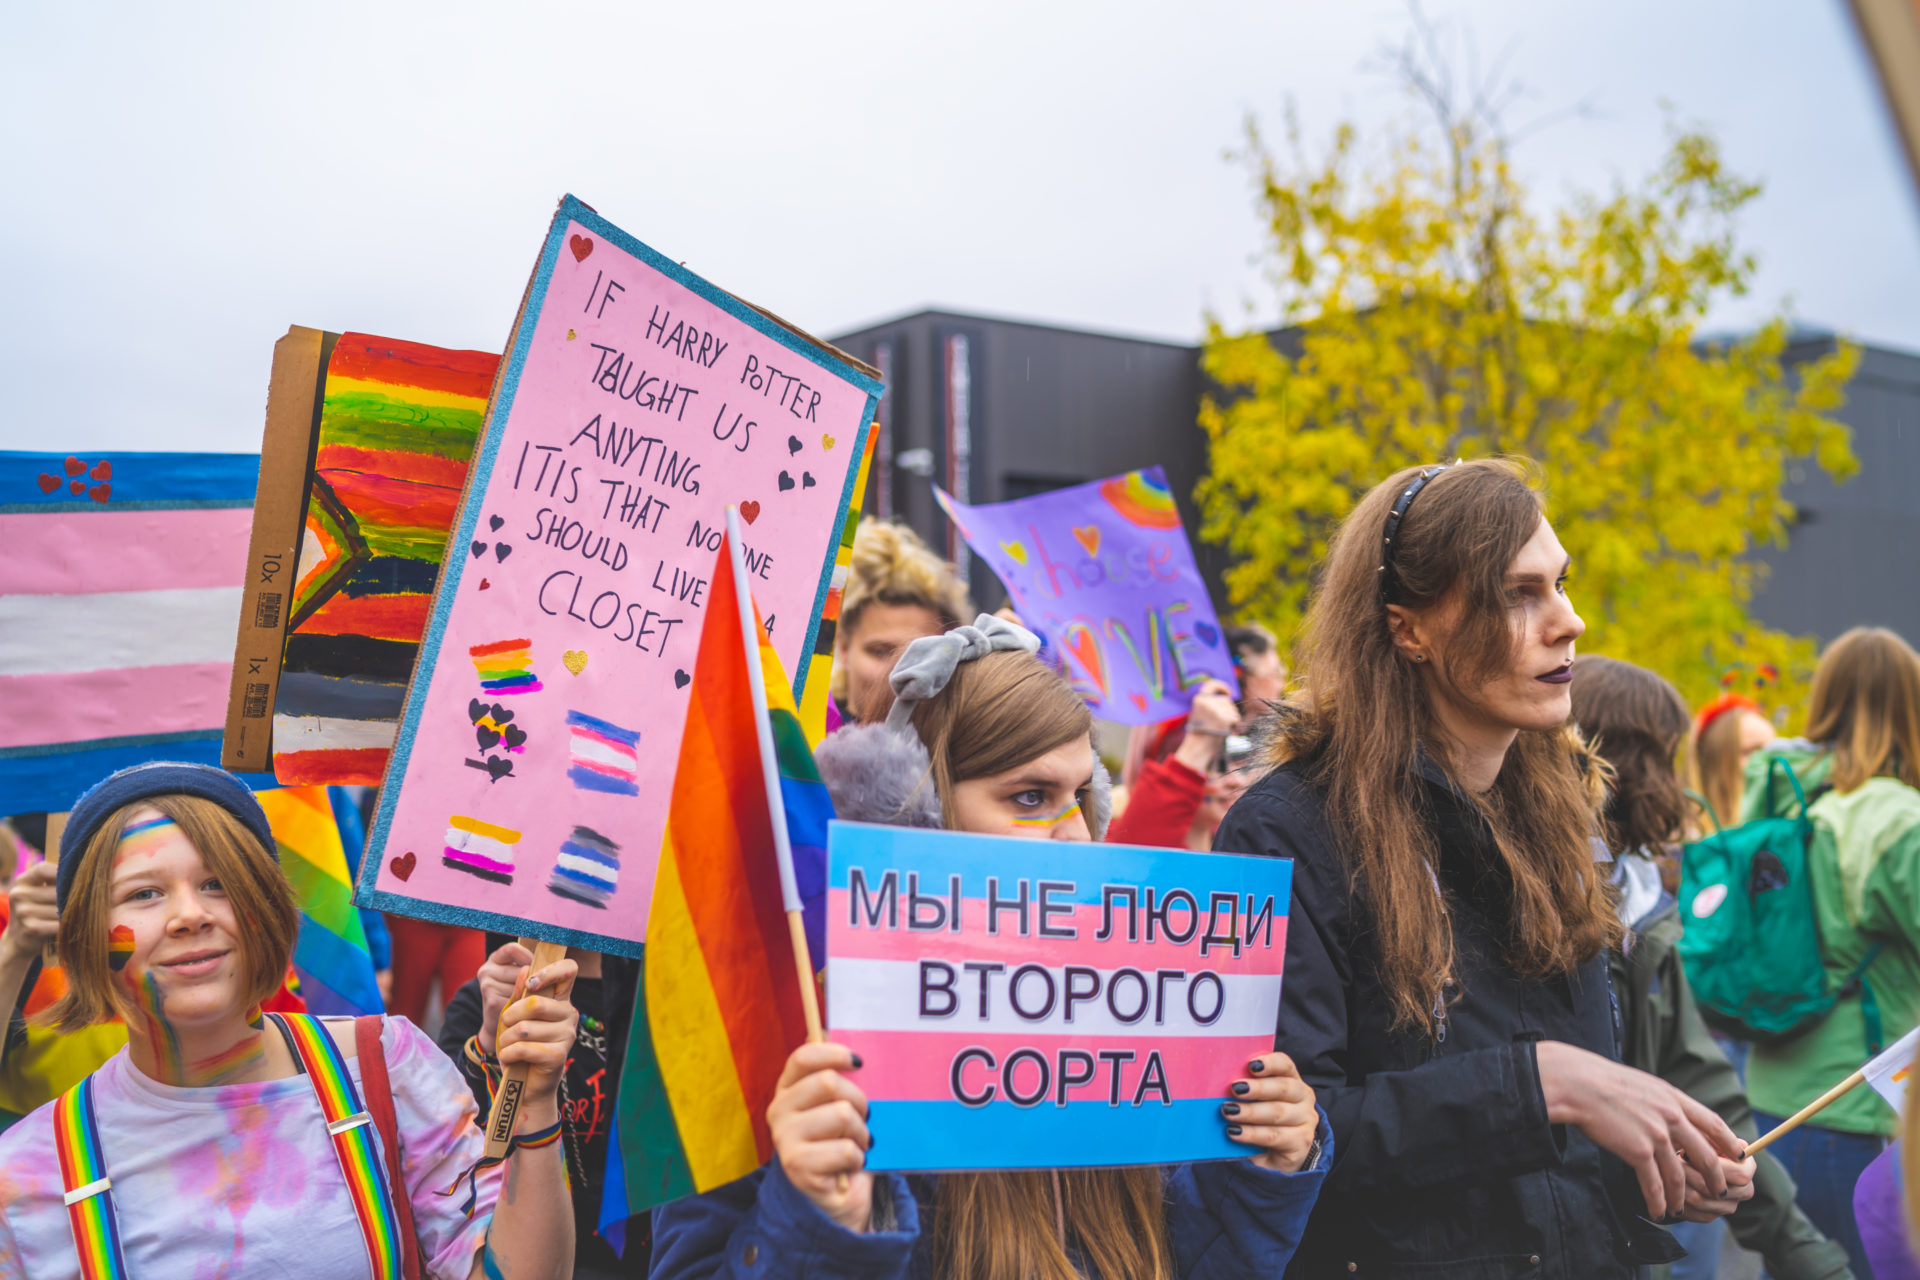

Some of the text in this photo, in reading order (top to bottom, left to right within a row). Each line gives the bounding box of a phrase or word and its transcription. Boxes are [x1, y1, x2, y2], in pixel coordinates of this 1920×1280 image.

[583, 269, 822, 423] IF HARRY POTTER
[590, 343, 758, 453] TAUGHT US
[569, 413, 701, 496] ANYTING
[261, 553, 282, 583] 10x
[526, 507, 628, 572] SHOULD
[652, 560, 707, 608] LIVE
[600, 478, 670, 534] THAT
[686, 520, 722, 552] NO
[741, 542, 774, 580] NE
[538, 570, 684, 658] CLOSET
[248, 656, 268, 674] 1x
[848, 866, 1275, 958] МЫ НЕ ЛЮДИ
[918, 960, 1225, 1026] ВТОРОГО
[496, 1096, 514, 1139] JOTUN
[950, 1046, 1172, 1109] СОРТА
